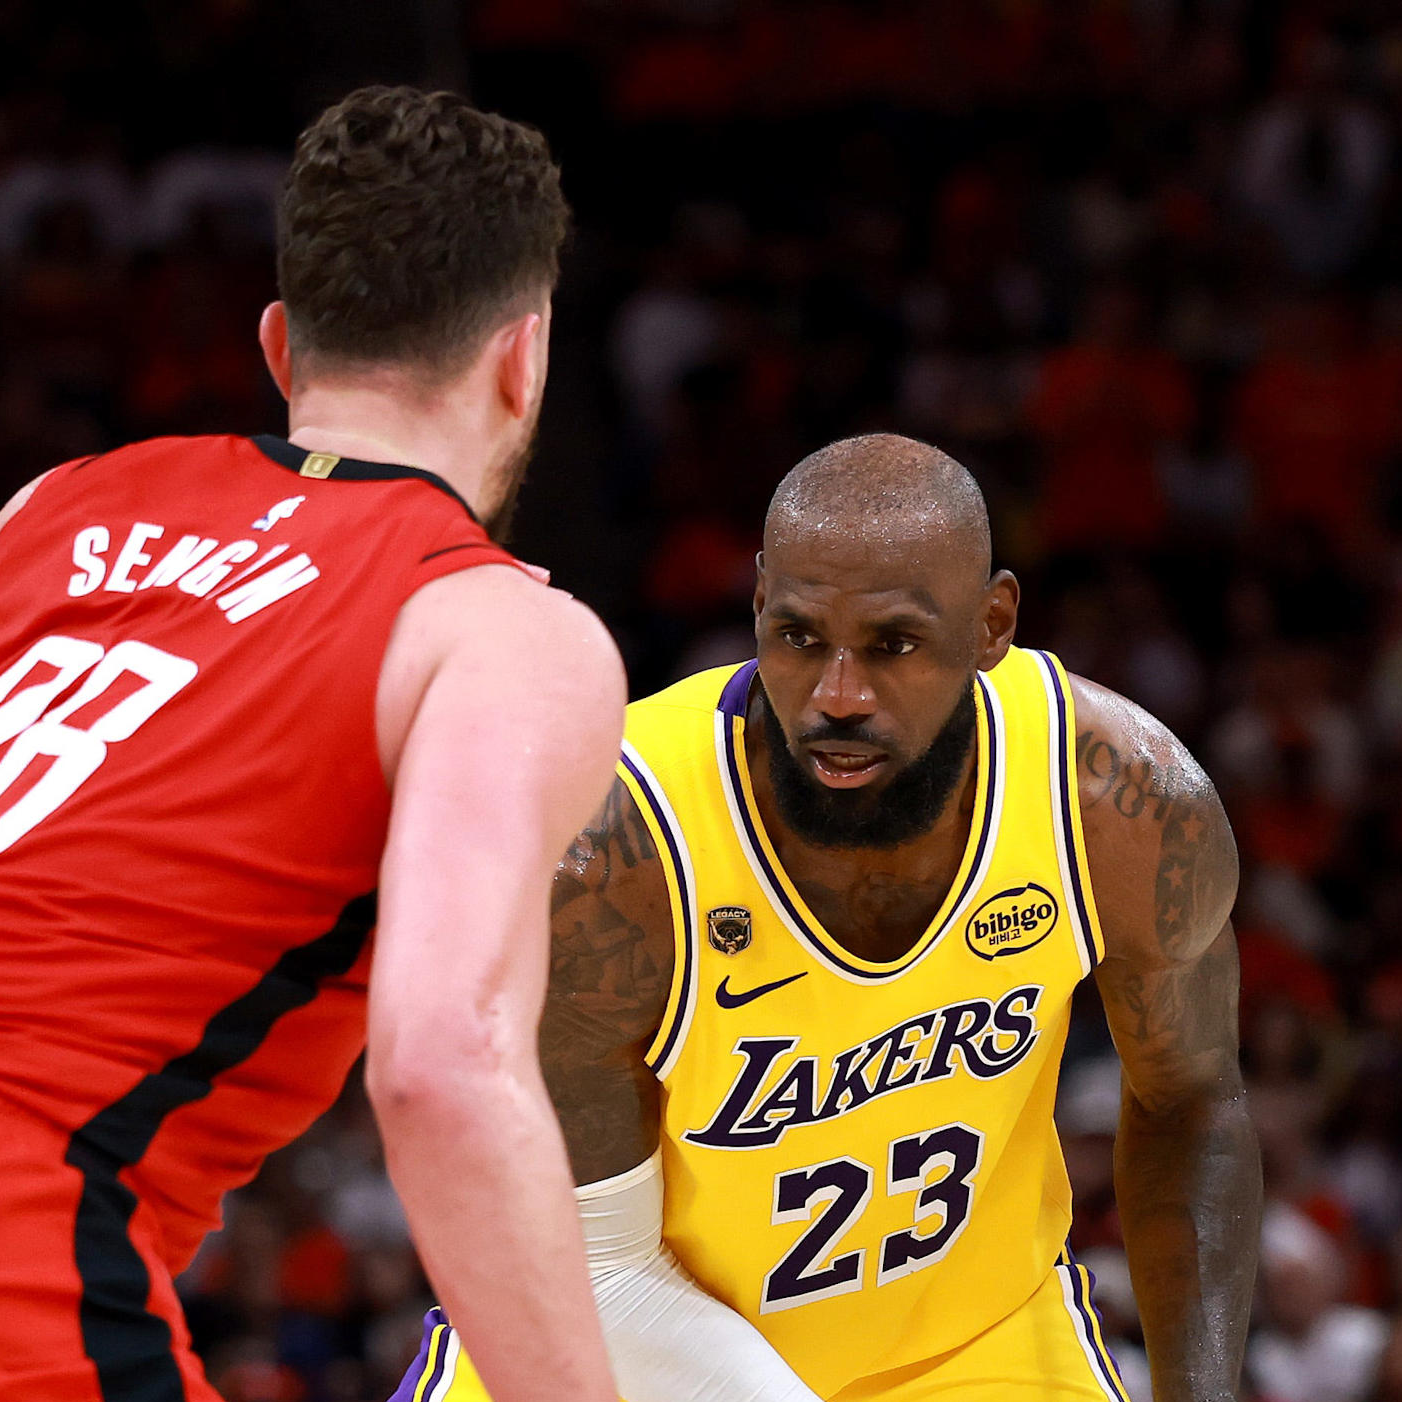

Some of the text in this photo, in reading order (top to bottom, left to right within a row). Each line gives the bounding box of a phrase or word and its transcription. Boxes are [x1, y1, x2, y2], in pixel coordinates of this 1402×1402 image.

[974, 904, 1052, 939] bibigo
[989, 928, 1021, 945] 비비고
[680, 984, 1044, 1151] LAKERS
[760, 1121, 986, 1315] 23
